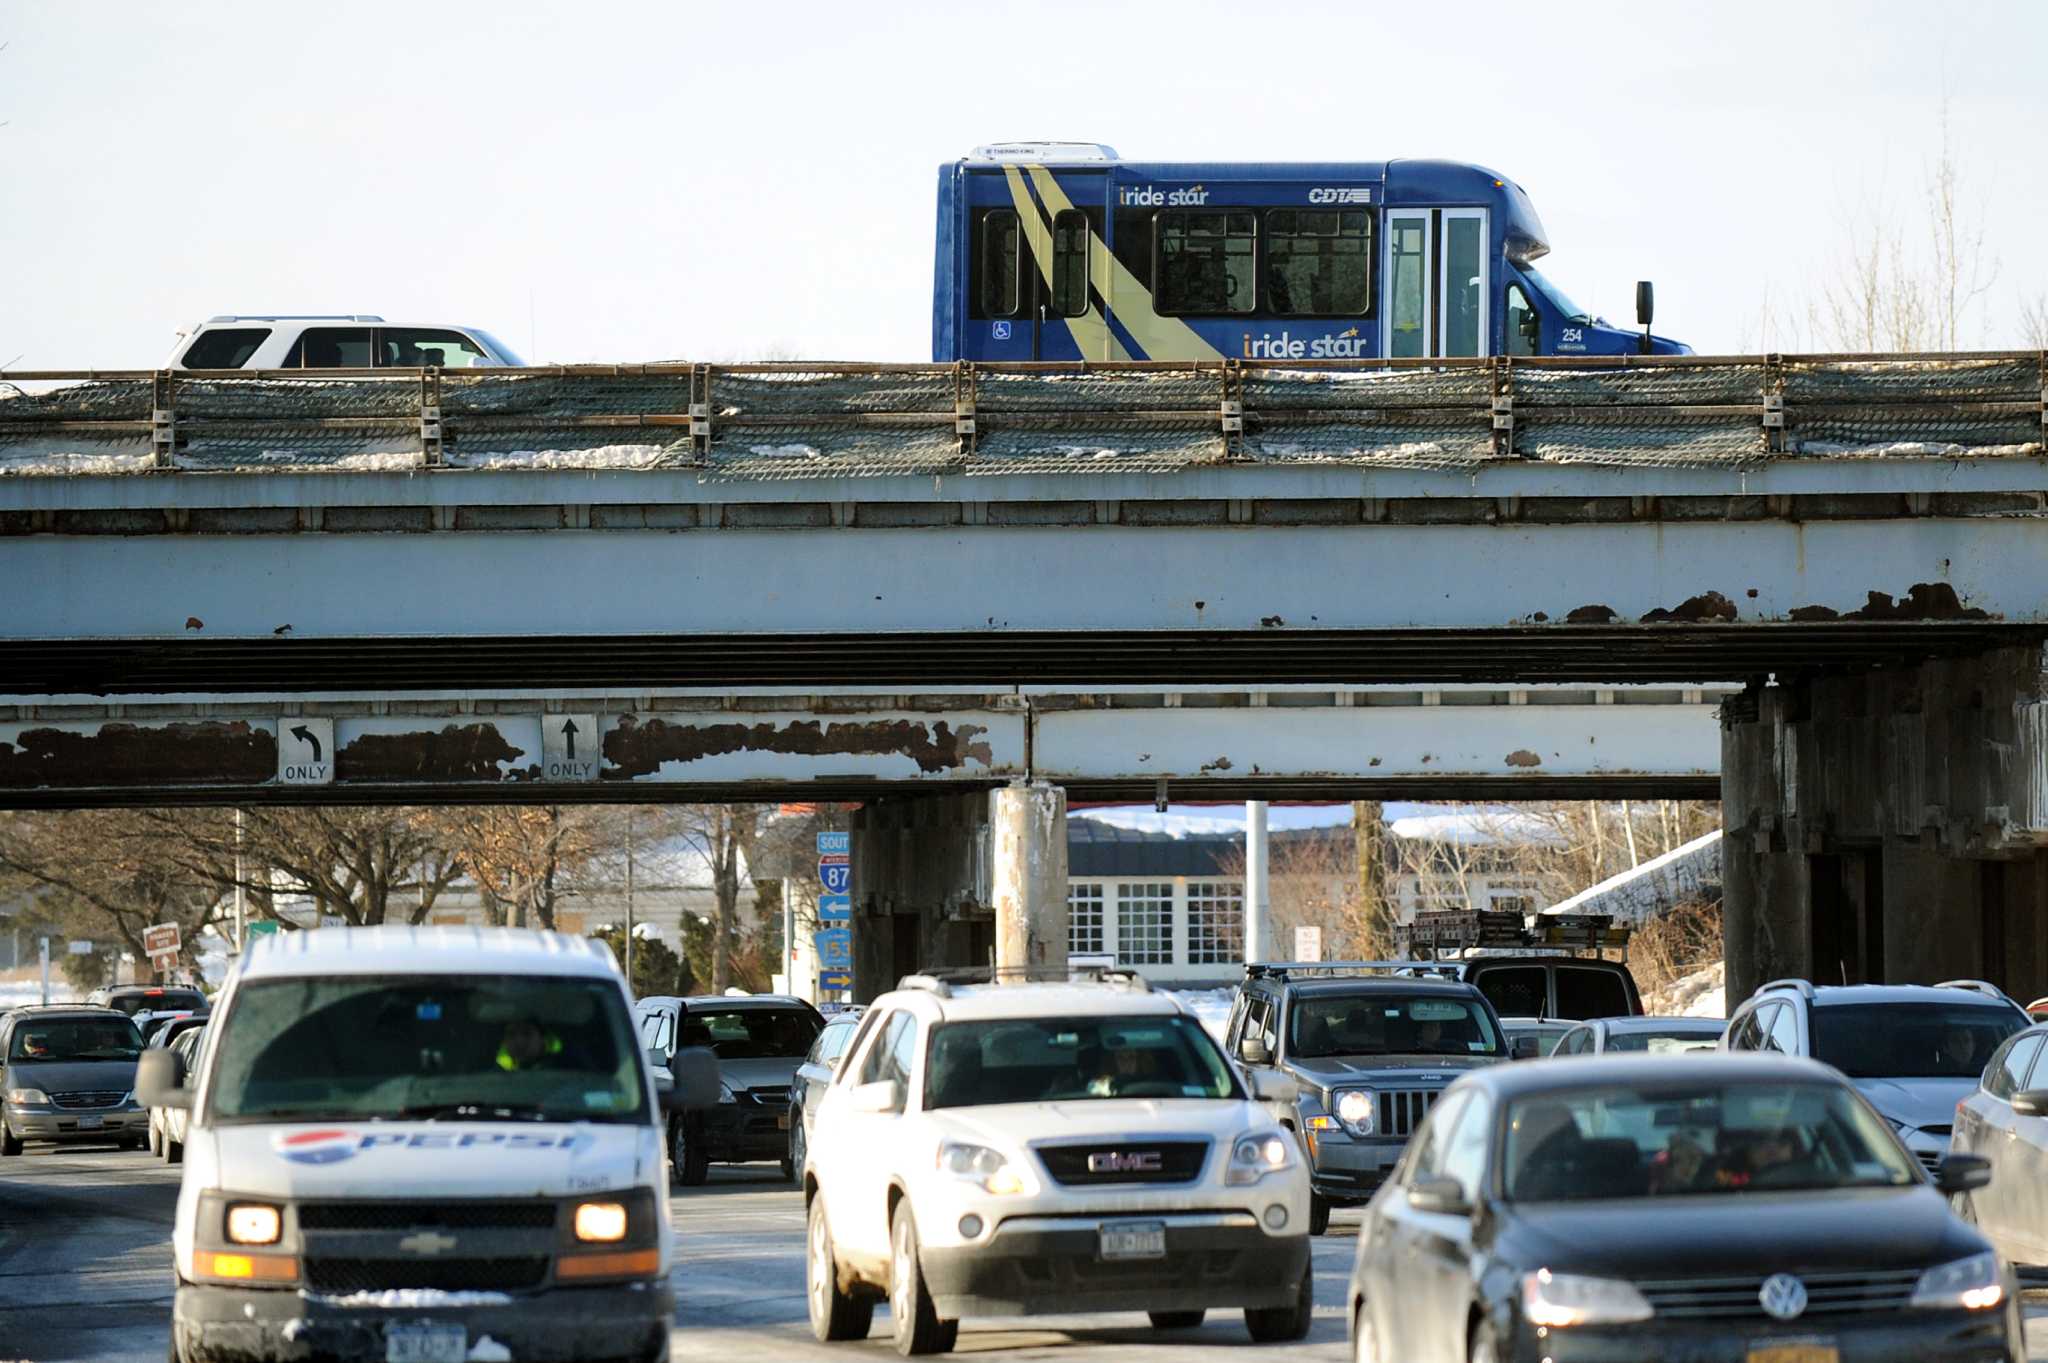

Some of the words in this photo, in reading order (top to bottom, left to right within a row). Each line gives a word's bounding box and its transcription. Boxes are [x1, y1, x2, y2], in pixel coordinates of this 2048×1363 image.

[1168, 188, 1209, 206] star
[1309, 188, 1370, 203] CDTA
[1562, 328, 1582, 342] 254
[1310, 334, 1367, 358] star
[285, 766, 327, 779] ONLY
[550, 763, 592, 777] ONLY
[820, 836, 848, 849] SOUT
[828, 867, 850, 887] 87
[360, 1134, 576, 1148] PEPSI
[1088, 1152, 1162, 1172] GMC
